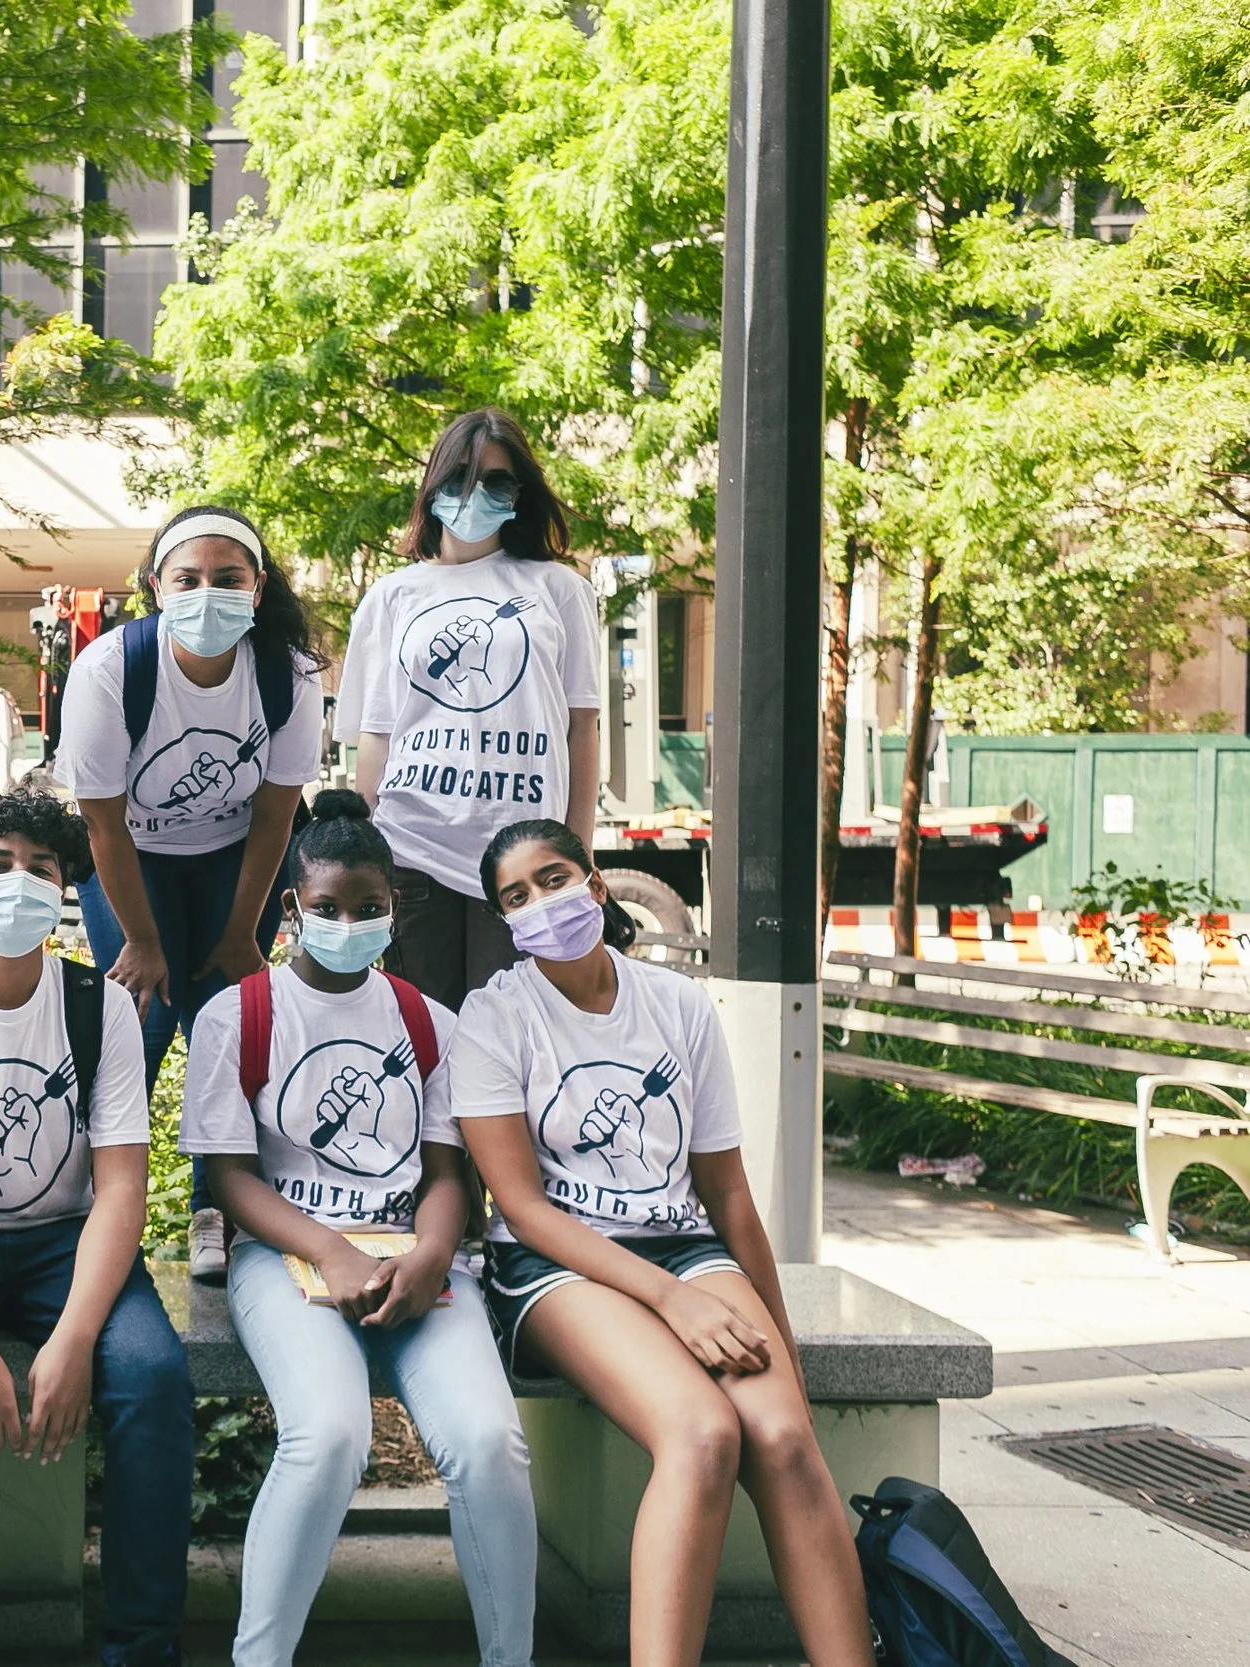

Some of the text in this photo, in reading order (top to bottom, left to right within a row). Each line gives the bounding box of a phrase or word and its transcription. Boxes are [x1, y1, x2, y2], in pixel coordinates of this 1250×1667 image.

[400, 728, 548, 756] YOUTH FOOD
[385, 764, 544, 804] ADVOCATES
[544, 1177, 628, 1216] OUTH
